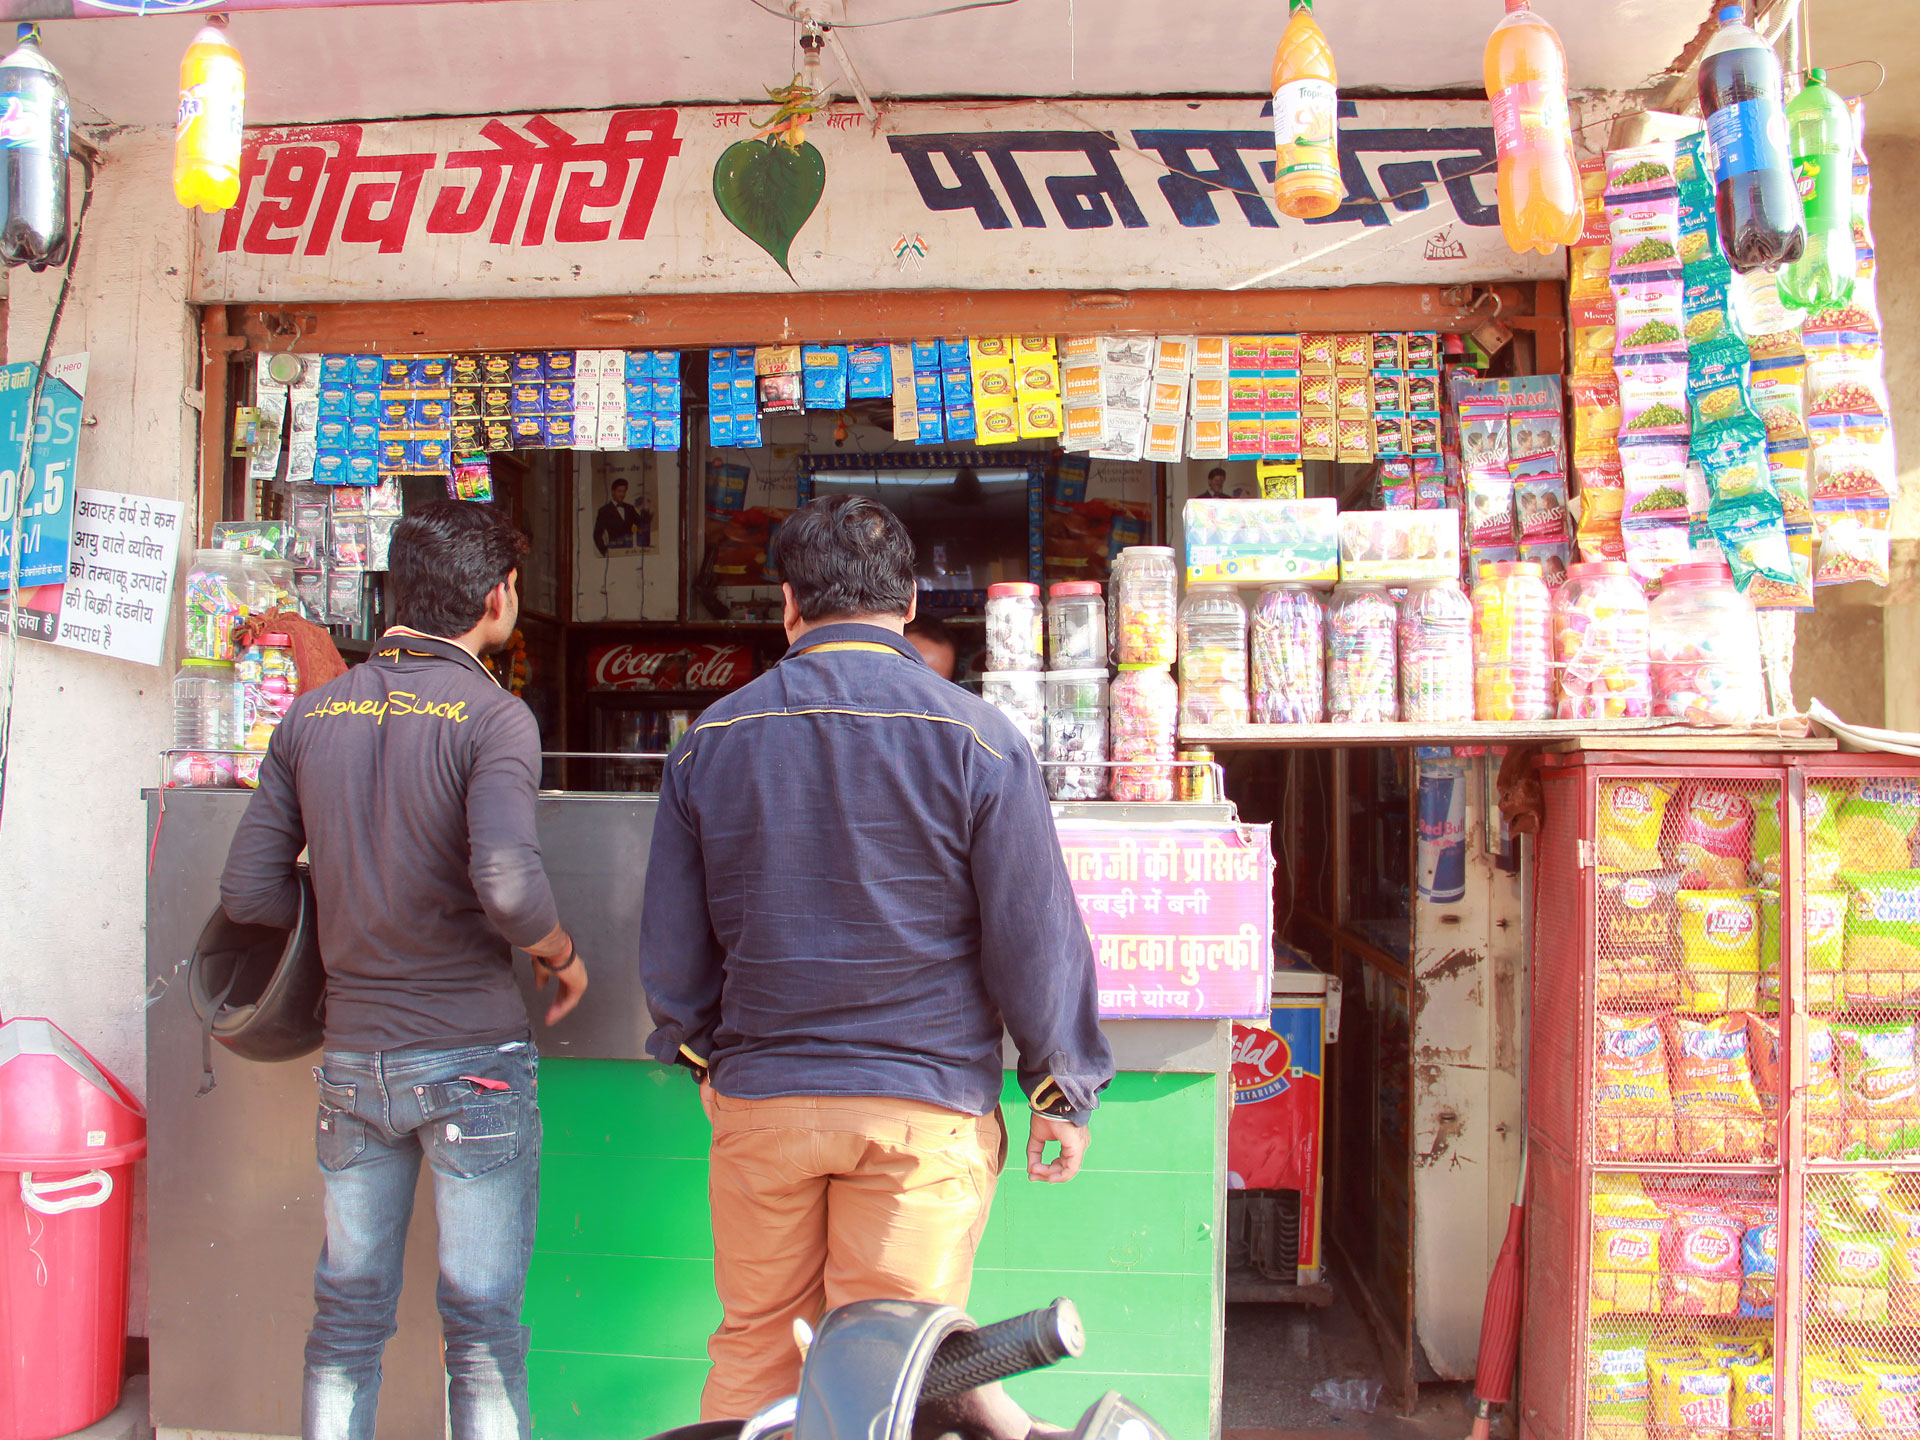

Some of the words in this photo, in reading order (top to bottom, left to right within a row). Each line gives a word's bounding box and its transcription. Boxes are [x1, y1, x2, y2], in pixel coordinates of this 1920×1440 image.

[425, 109, 683, 248] गौरी
[886, 130, 1149, 229] पान
[1425, 241, 1467, 260] FIROZ
[63, 362, 83, 372] Hero
[769, 364, 788, 373] 120
[1496, 391, 1547, 407] PARAG
[1420, 490, 1446, 499] GEMS
[79, 500, 116, 525] अठारह
[140, 503, 152, 527] से
[154, 511, 177, 531] कम
[74, 530, 99, 557] आयु
[102, 531, 125, 555] वाले
[128, 536, 164, 562] व्यक्ति
[69, 556, 86, 580] को
[88, 564, 129, 594] तम्बाकू
[131, 570, 168, 595] उत्पादों
[65, 588, 82, 610] की
[84, 589, 112, 617] बिक्री
[115, 596, 153, 624] दंडनीय
[61, 622, 101, 646] अपराध
[103, 624, 112, 650] है
[1419, 818, 1443, 836] Red
[1444, 817, 1466, 835] Bull
[1142, 837, 1181, 882] की
[1140, 887, 1163, 915] में
[1165, 887, 1211, 915] बनी
[1098, 934, 1176, 971] मटका
[1178, 922, 1263, 986] कुल्फी
[1140, 984, 1190, 1009] योग्य
[1686, 1062, 1729, 1078] Masala
